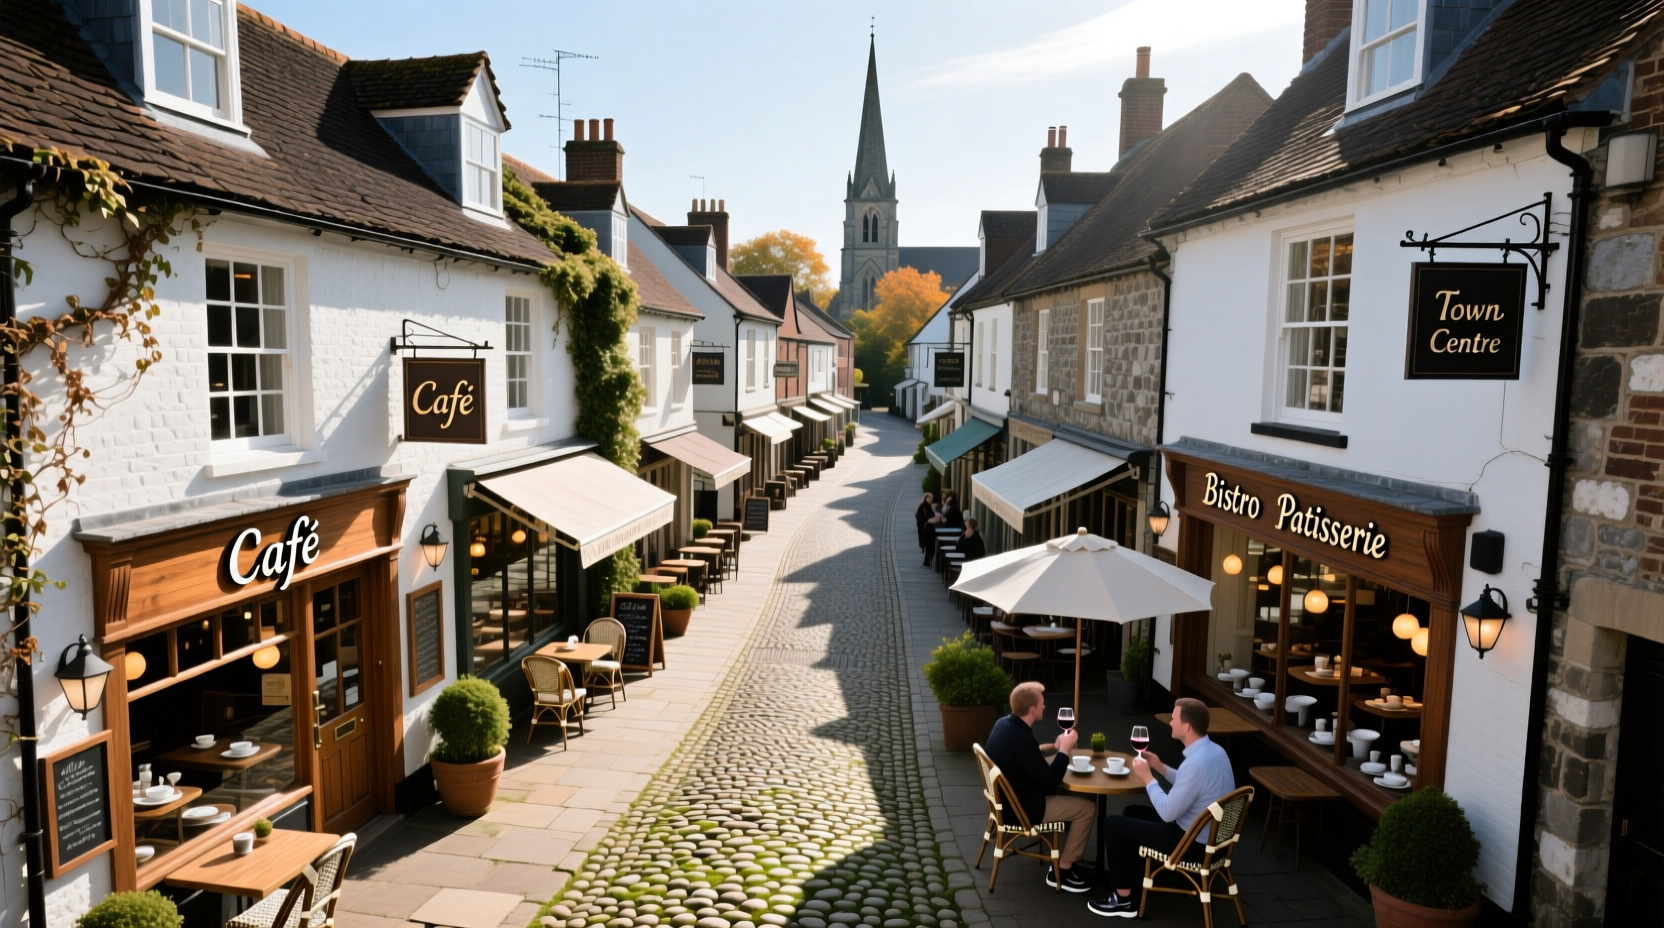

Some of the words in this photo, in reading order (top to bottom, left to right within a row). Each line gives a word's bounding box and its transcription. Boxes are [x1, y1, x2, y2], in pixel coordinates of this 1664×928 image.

[1435, 289, 1505, 322] Town
[1429, 328, 1501, 354] Centre
[412, 379, 474, 430] Café
[1202, 472, 1260, 519] Bistro
[1274, 493, 1386, 559] Patisserie
[229, 515, 320, 591] Café
